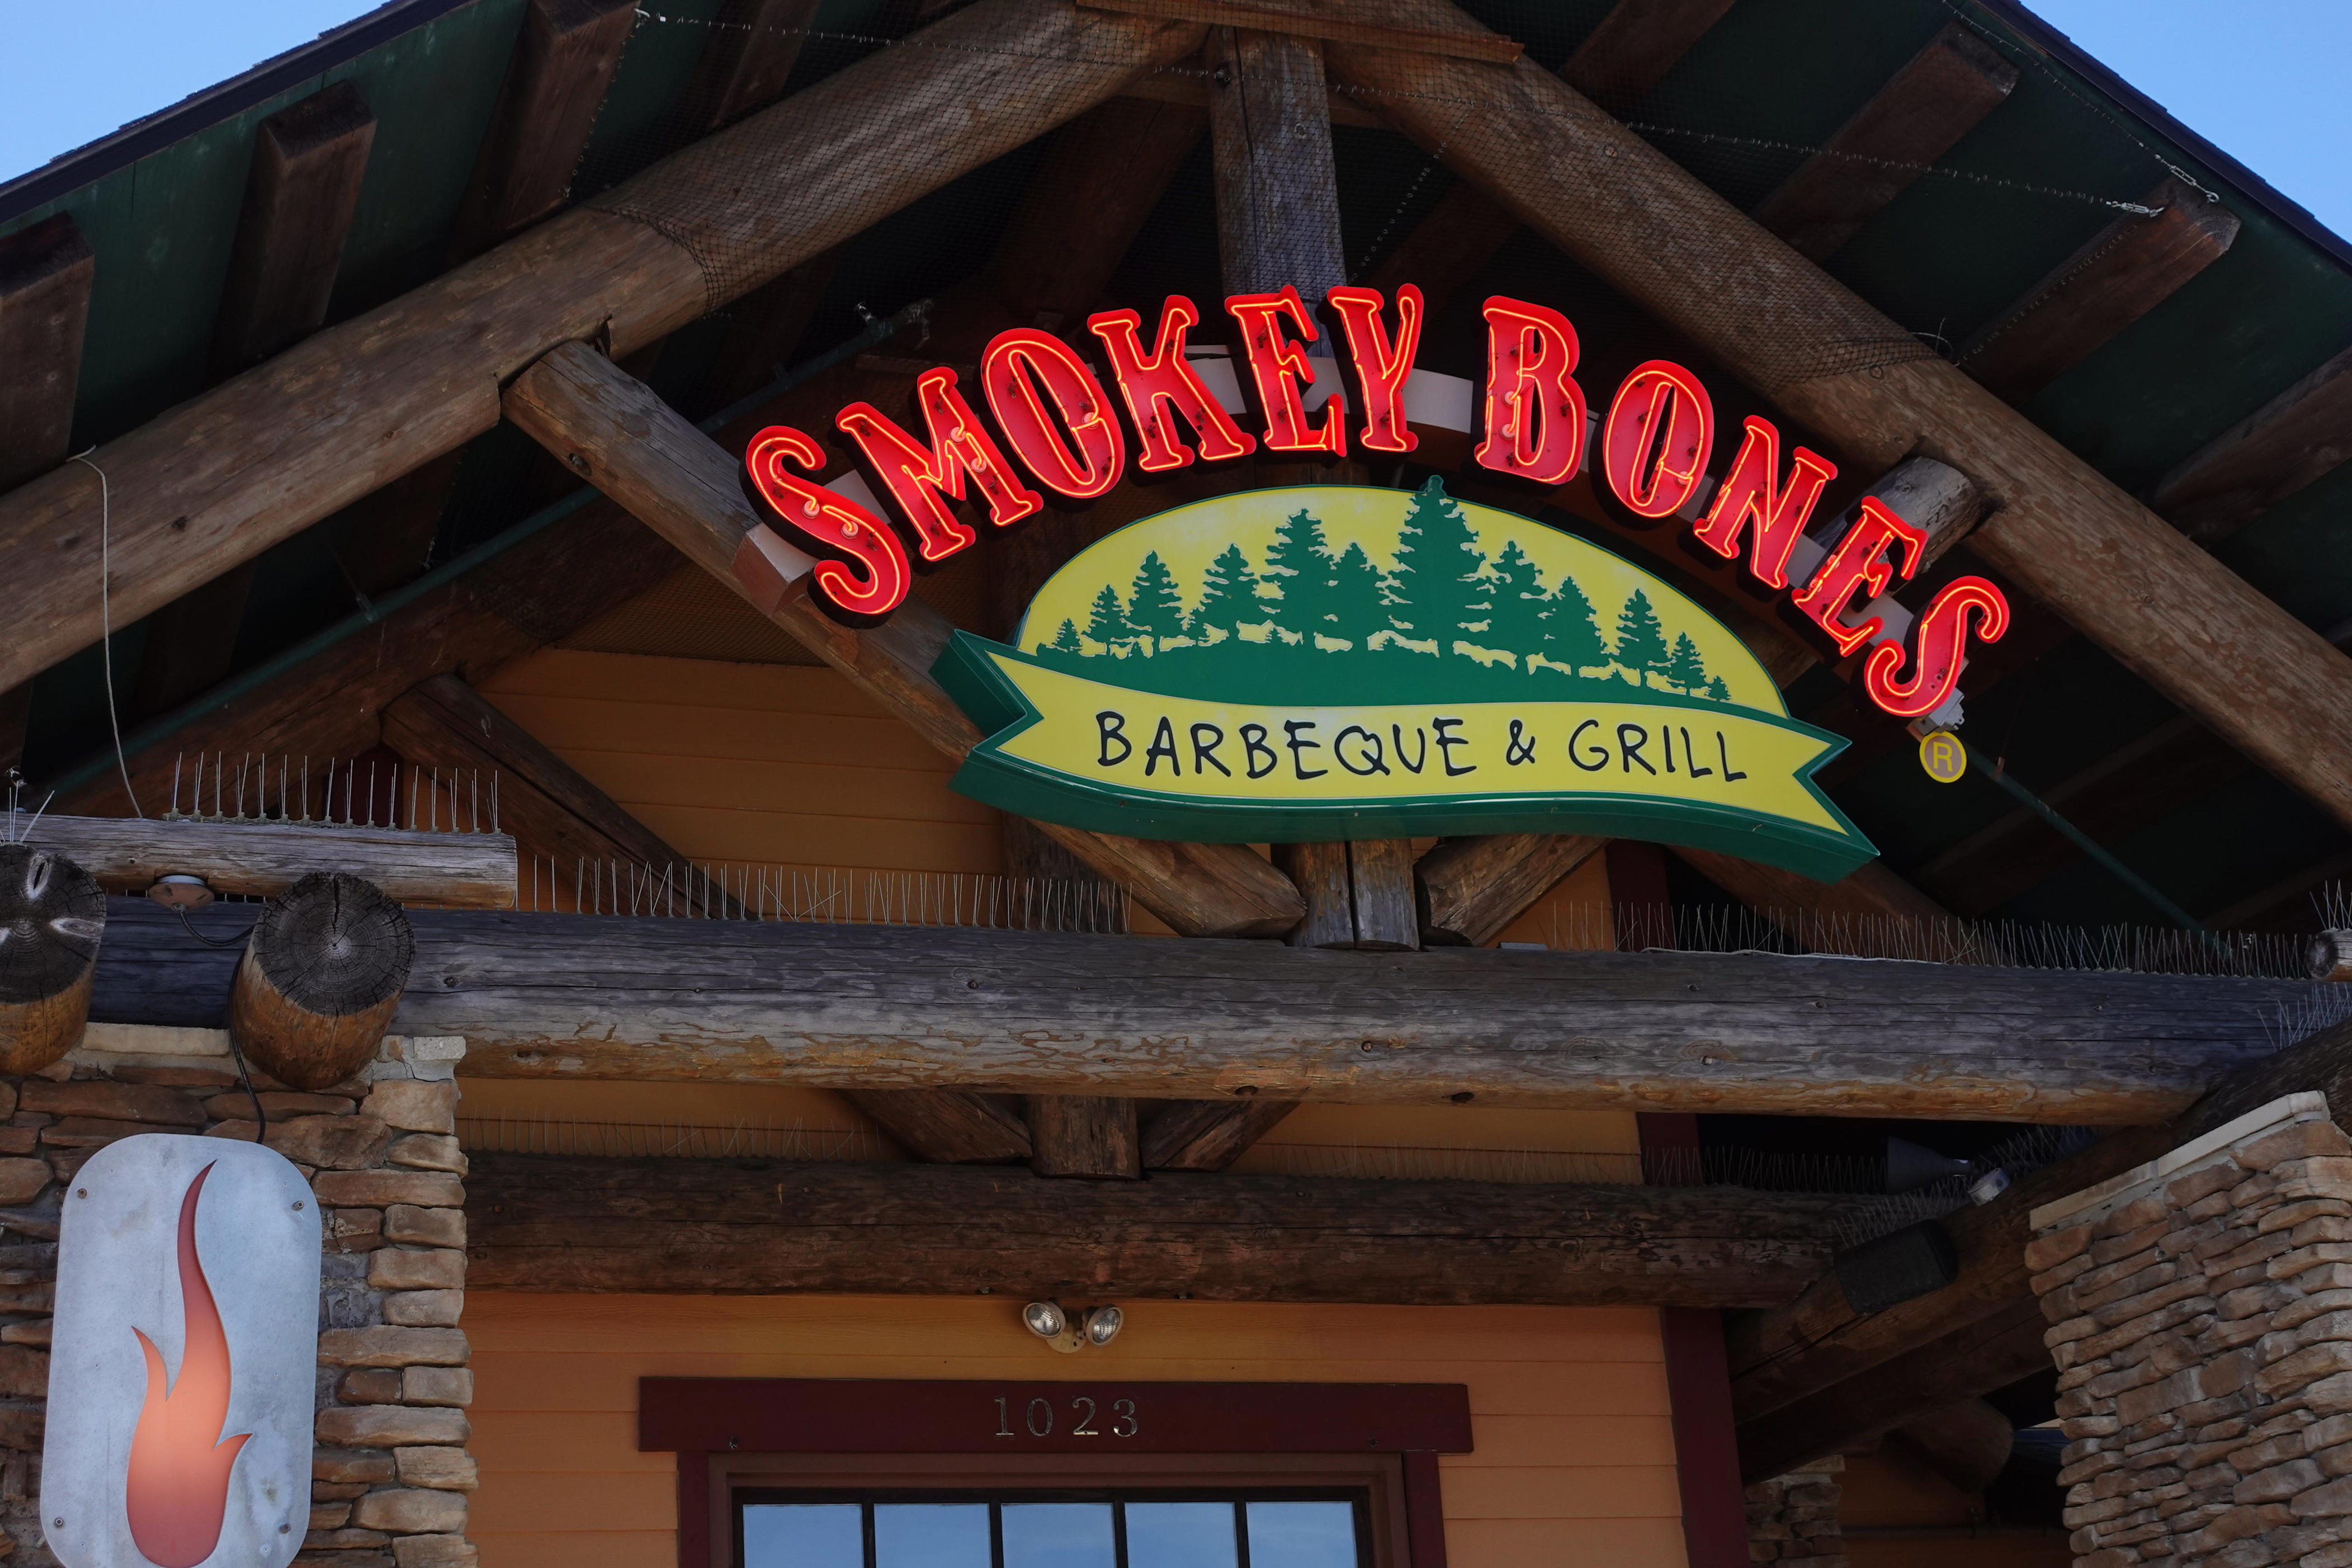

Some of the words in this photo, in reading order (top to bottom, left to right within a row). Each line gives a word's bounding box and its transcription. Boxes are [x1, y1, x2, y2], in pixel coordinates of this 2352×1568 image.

[746, 283, 1424, 614] SMOKEY
[1474, 295, 2010, 717] BONES
[1096, 710, 1476, 780] BARBEQUE
[1506, 719, 1536, 766] &
[1568, 719, 1748, 782] GRILL
[995, 1396, 1137, 1437] 1023
